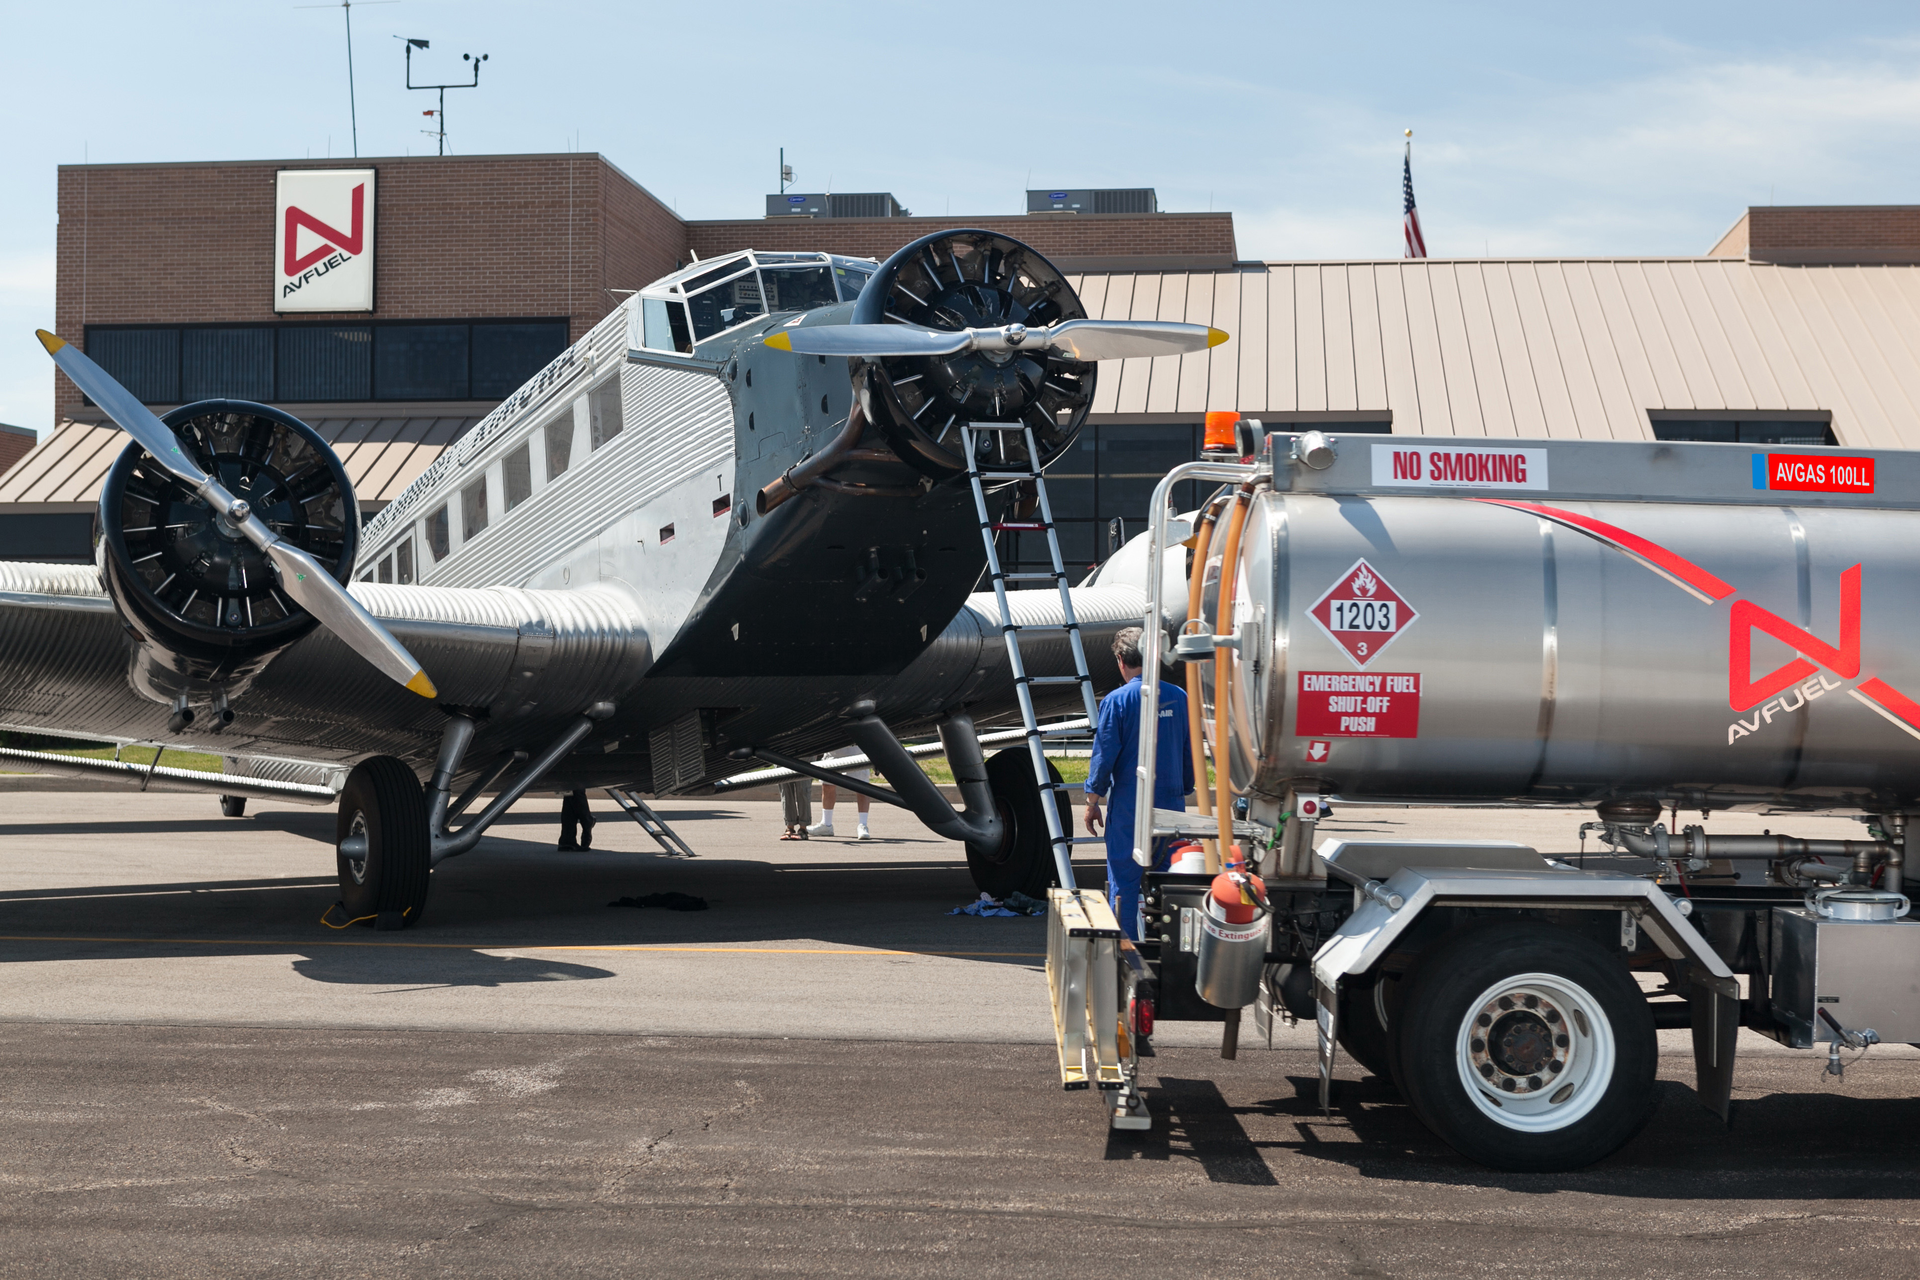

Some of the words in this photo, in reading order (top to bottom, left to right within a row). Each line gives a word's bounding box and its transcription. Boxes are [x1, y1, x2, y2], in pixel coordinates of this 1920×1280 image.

[283, 252, 352, 299] AVFUEL
[1393, 451, 1421, 480] NO
[1429, 452, 1527, 483] SMOKING
[1776, 462, 1826, 484] AVGAS
[1829, 465, 1870, 486] 100LL
[1336, 602, 1390, 631] 1203
[1357, 642, 1368, 656] 3
[1303, 674, 1382, 693] EMERGENCY
[1386, 676, 1416, 693] FUEL
[1328, 696, 1390, 713] SHUT-OFF
[1728, 675, 1842, 745] AVFUEL
[1340, 716, 1376, 732] PUSH
